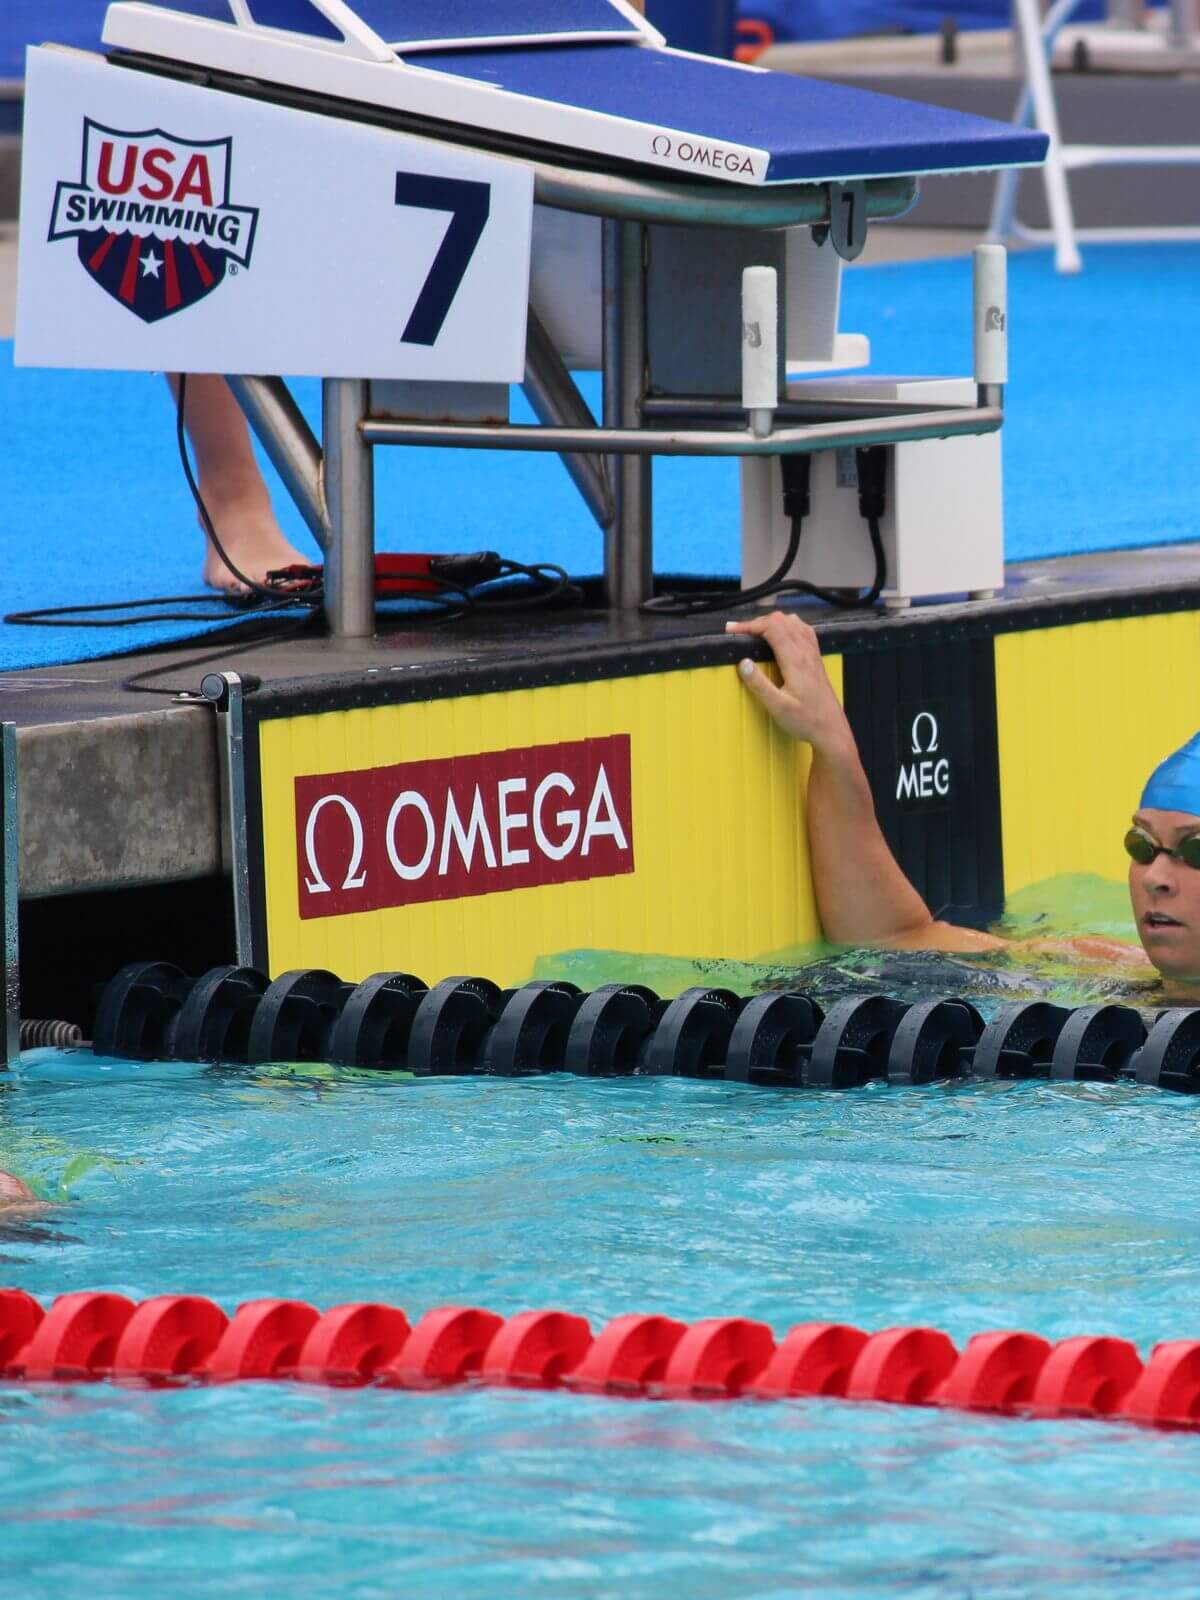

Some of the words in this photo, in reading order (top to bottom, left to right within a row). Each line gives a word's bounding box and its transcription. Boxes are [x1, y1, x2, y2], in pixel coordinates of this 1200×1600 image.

[97, 141, 214, 207] USA
[678, 143, 754, 176] OMEGA
[66, 194, 241, 246] SWIMMING
[394, 170, 491, 346] 7
[386, 762, 628, 880] OMEGA
